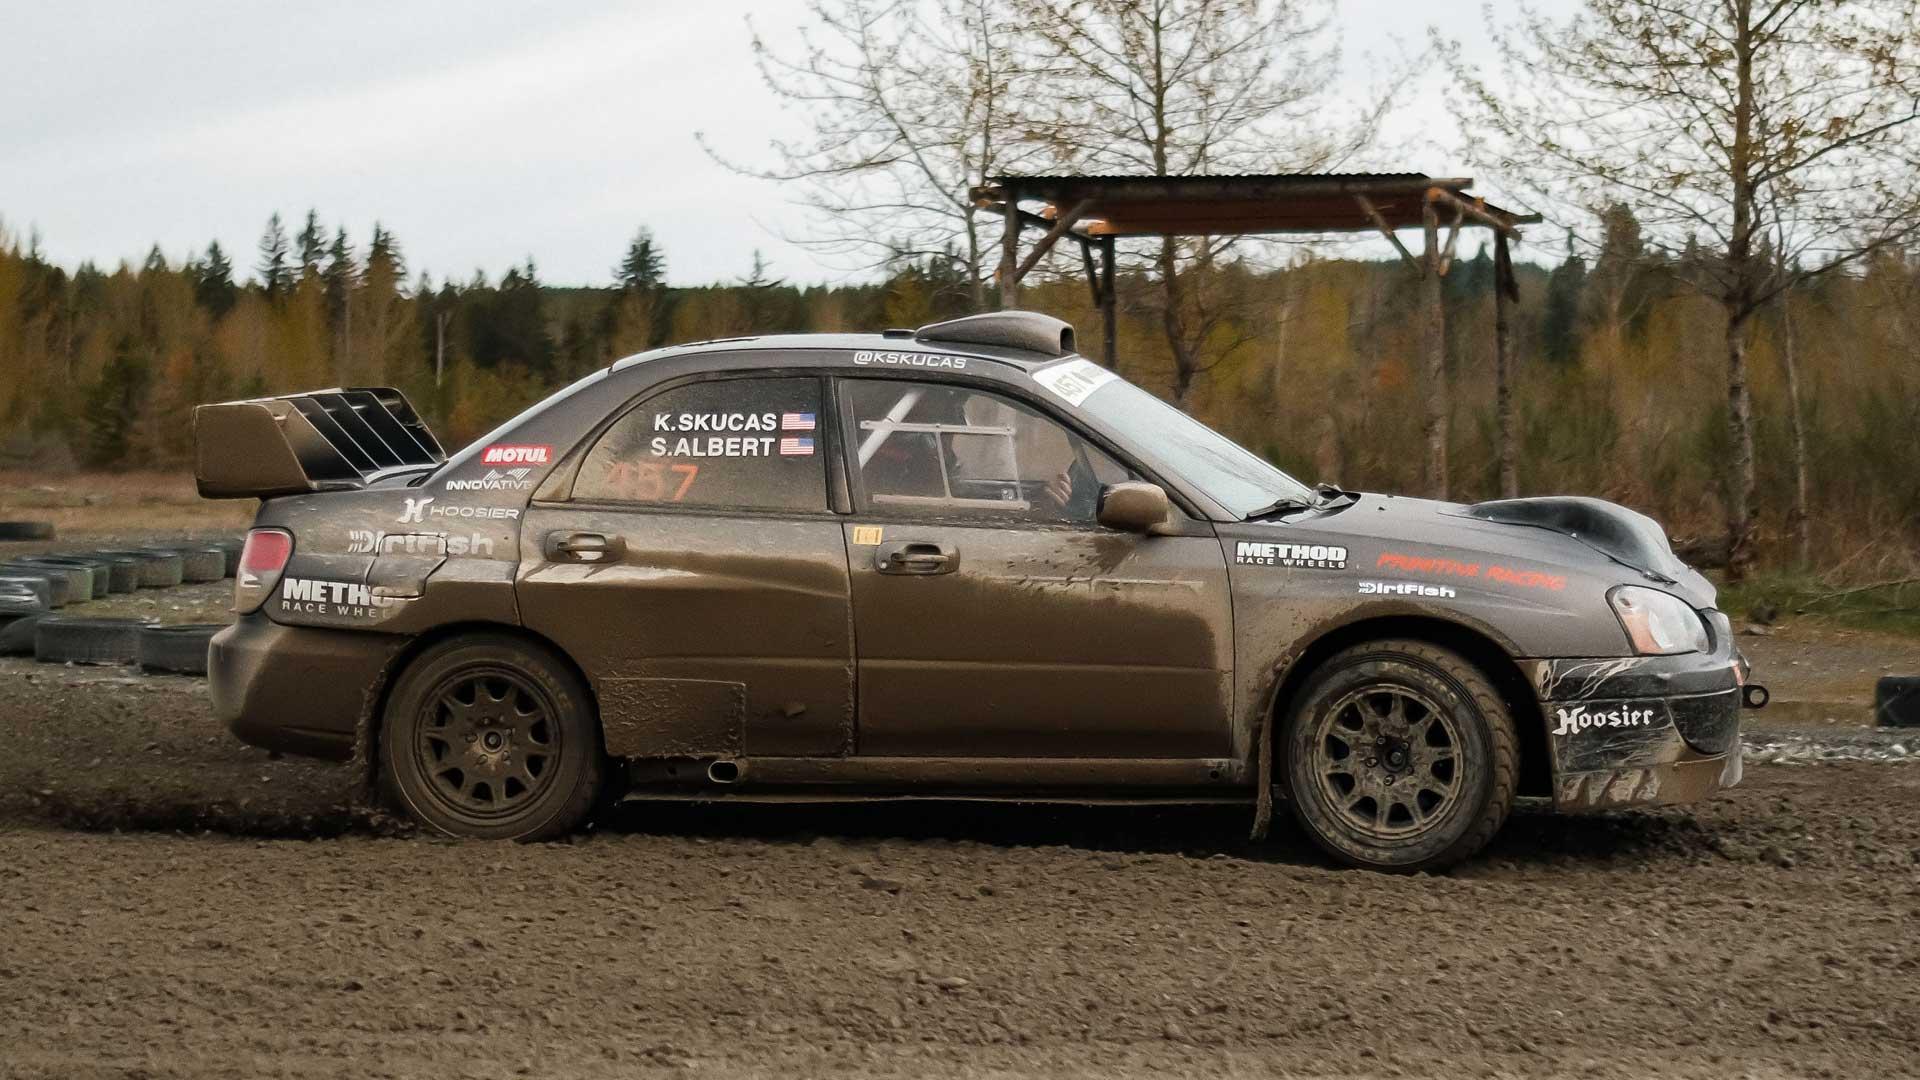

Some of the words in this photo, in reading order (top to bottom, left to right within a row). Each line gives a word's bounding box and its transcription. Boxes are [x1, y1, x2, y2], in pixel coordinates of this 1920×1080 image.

[854, 351, 967, 369] @KSKUCAS
[654, 413, 777, 431] K.SKUCAS
[485, 448, 548, 462] MOTUL
[651, 437, 776, 457] S.ALBERT
[446, 480, 532, 490] INNOVATIVE
[430, 506, 520, 520] HOOSIER
[1237, 542, 1347, 561] METHOD
[1236, 557, 1274, 565] RACE
[1283, 558, 1345, 569] WHEELS
[283, 578, 394, 608] METHO
[282, 601, 327, 613] RACE
[1552, 705, 1654, 735] Hoosier
